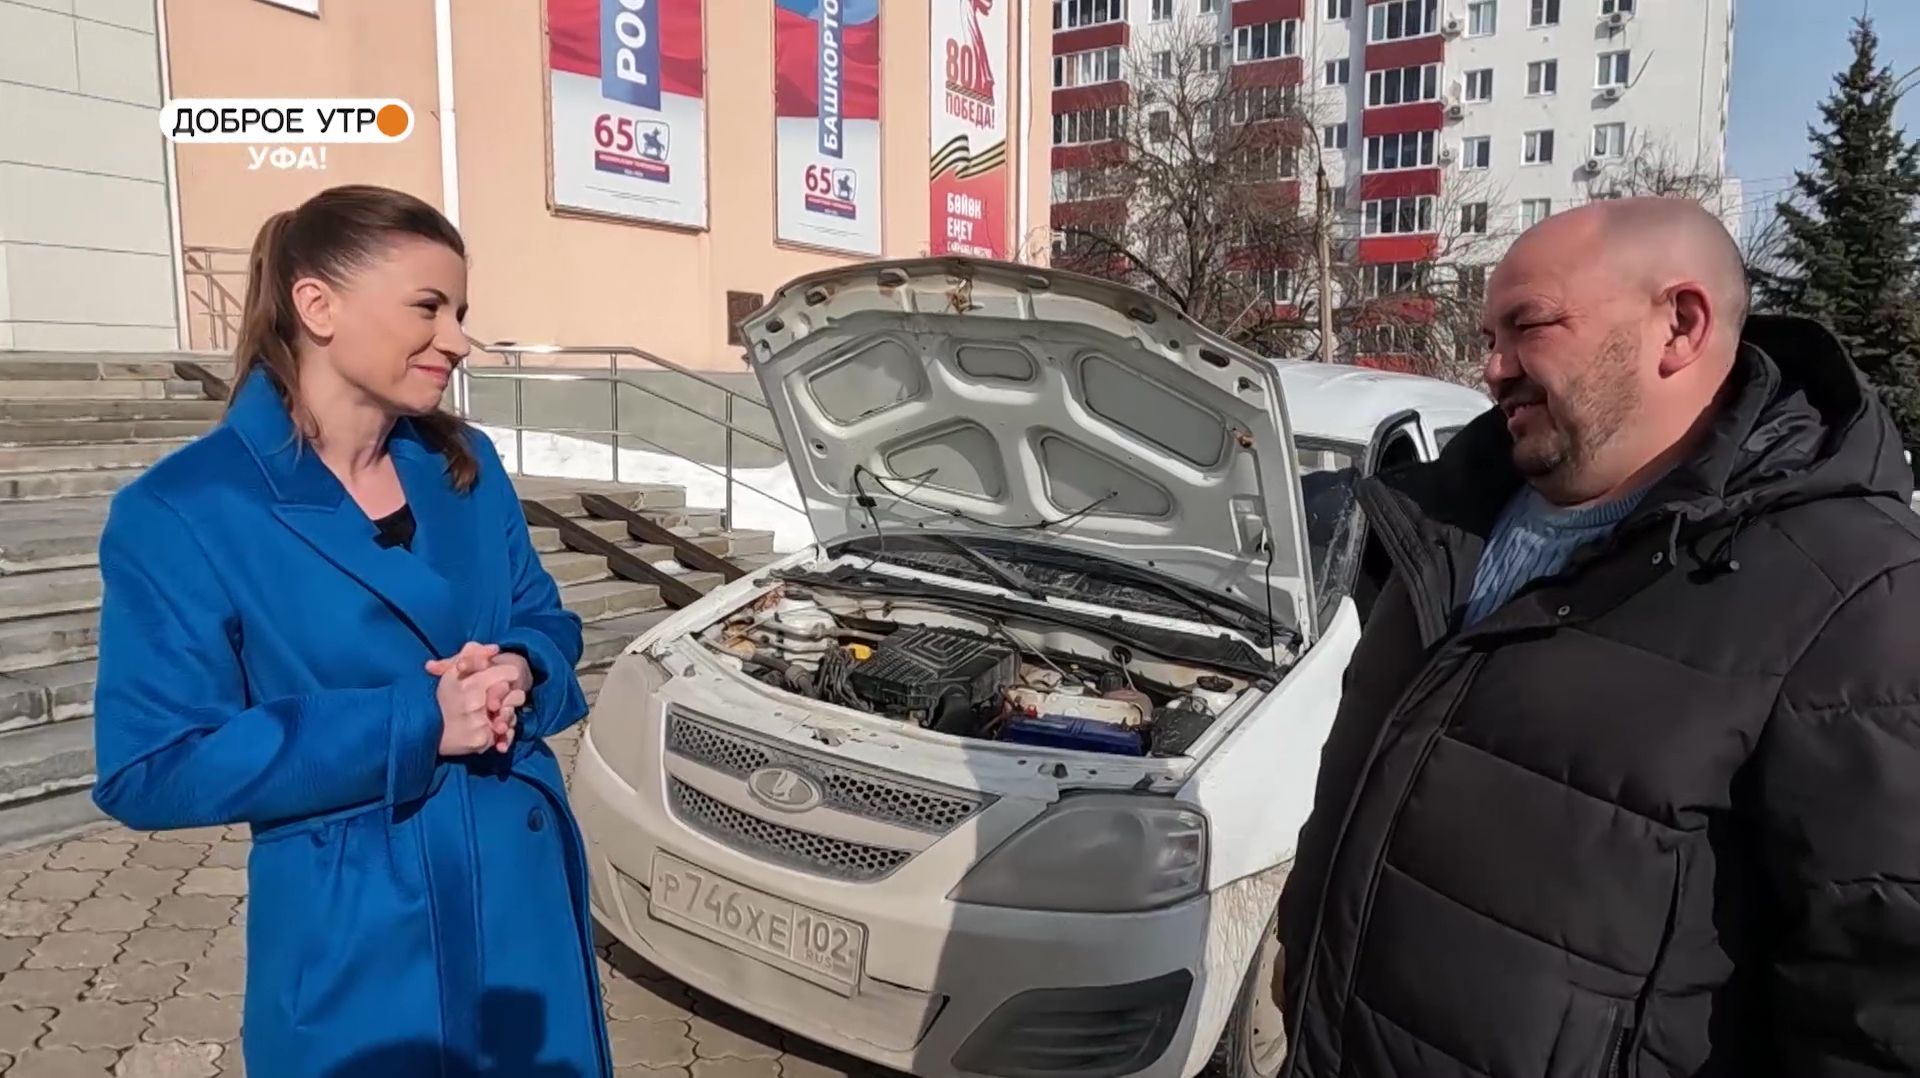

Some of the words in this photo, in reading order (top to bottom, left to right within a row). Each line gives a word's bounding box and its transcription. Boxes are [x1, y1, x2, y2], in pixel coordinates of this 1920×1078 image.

[946, 38, 972, 88] 80
[945, 91, 995, 129] ПОБЕДА!
[594, 113, 634, 152] 65
[805, 164, 831, 195] 65
[797, 916, 849, 963] 102
[805, 949, 832, 968] RUS
